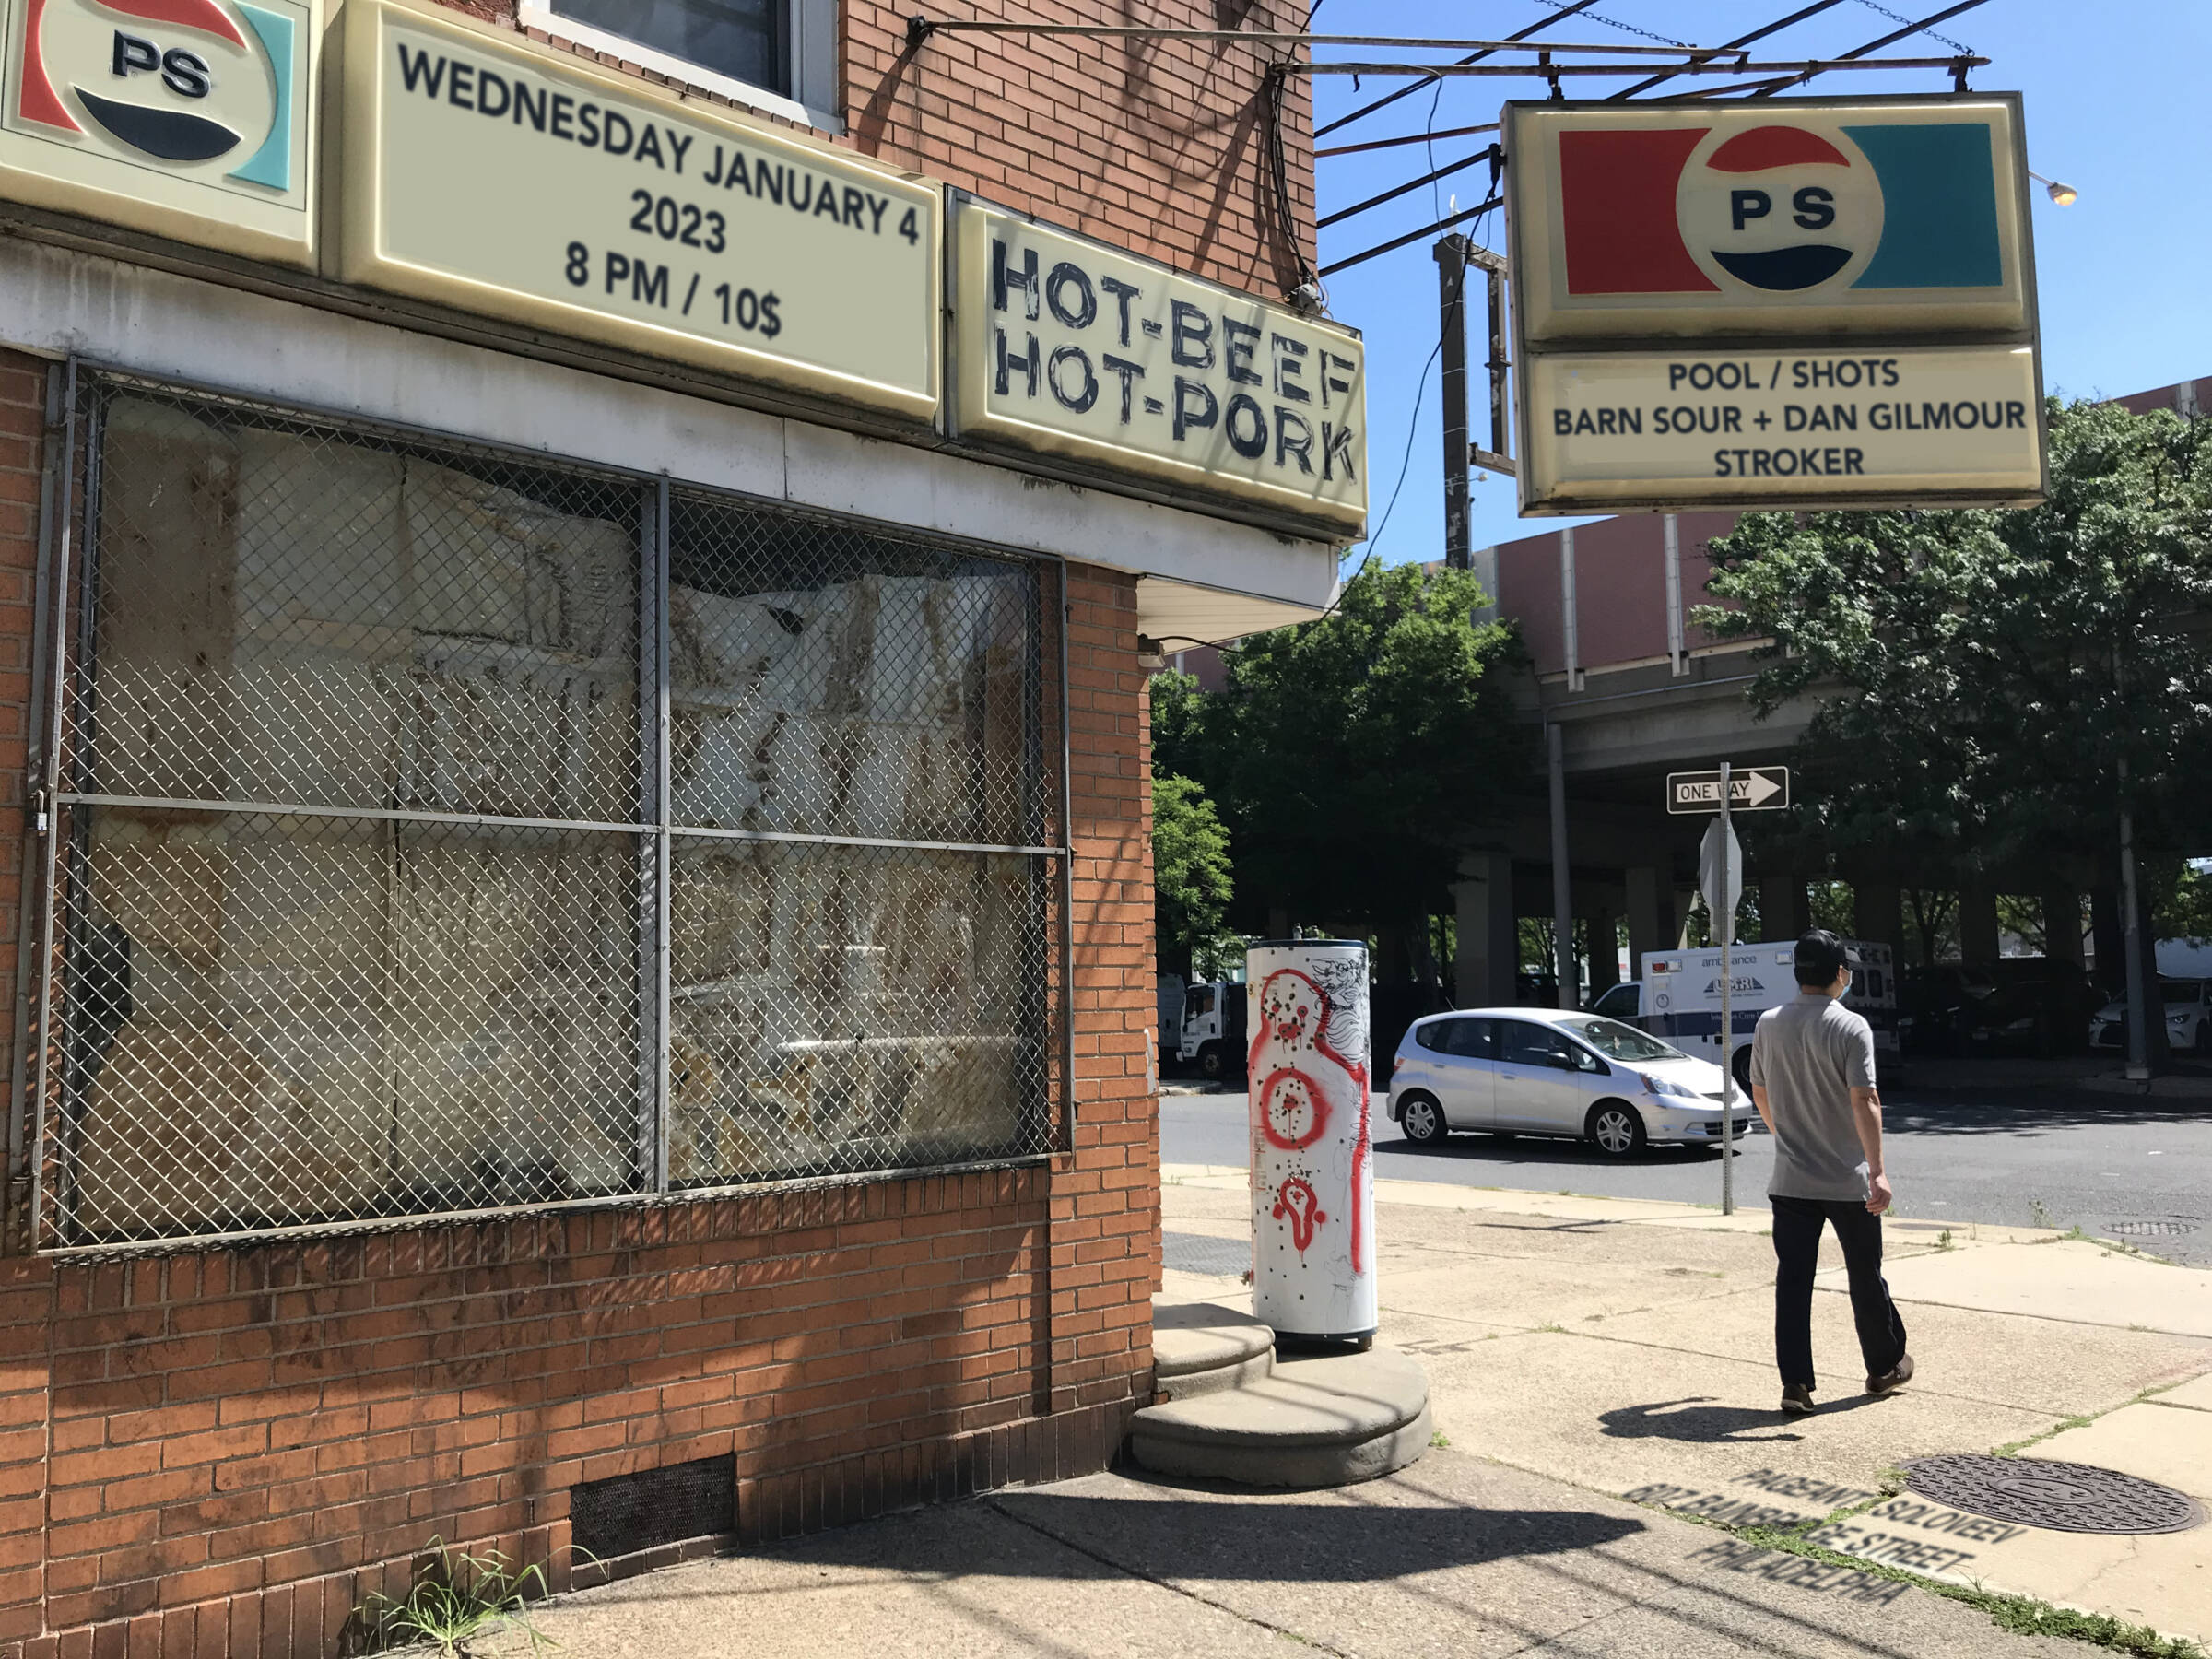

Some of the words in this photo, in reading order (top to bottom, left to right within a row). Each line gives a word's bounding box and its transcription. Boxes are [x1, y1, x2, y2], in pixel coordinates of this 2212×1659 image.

[113, 29, 211, 99] PS
[398, 43, 693, 174] WEDNESDAY
[703, 144, 888, 235] JANUARY
[899, 207, 920, 246] 4
[630, 189, 726, 253] 2023
[565, 241, 589, 286] 8
[606, 251, 670, 308] PM
[682, 273, 700, 316] /
[714, 282, 782, 339] 10$
[992, 238, 1355, 409] HOT-BEEF
[994, 321, 1358, 486] HOT-PORK
[1669, 361, 1759, 391] POOL
[1770, 360, 1781, 390] /
[1793, 359, 1899, 388] SHOTS
[1554, 407, 1642, 436] BARN
[1653, 406, 1742, 434] SOUR
[1783, 404, 1857, 432] DAN
[1868, 400, 2026, 430] GILMOUR
[1714, 447, 1865, 477] STROKER
[1680, 784, 1712, 800] ONE
[1717, 782, 1750, 798] AY
[1729, 1468, 1875, 1508] PAGEANT
[1871, 1500, 2029, 1545] SOLOVEEV
[1682, 1541, 1912, 1607] PHILADELPHIA
[1844, 1533, 1976, 1572] STREET
